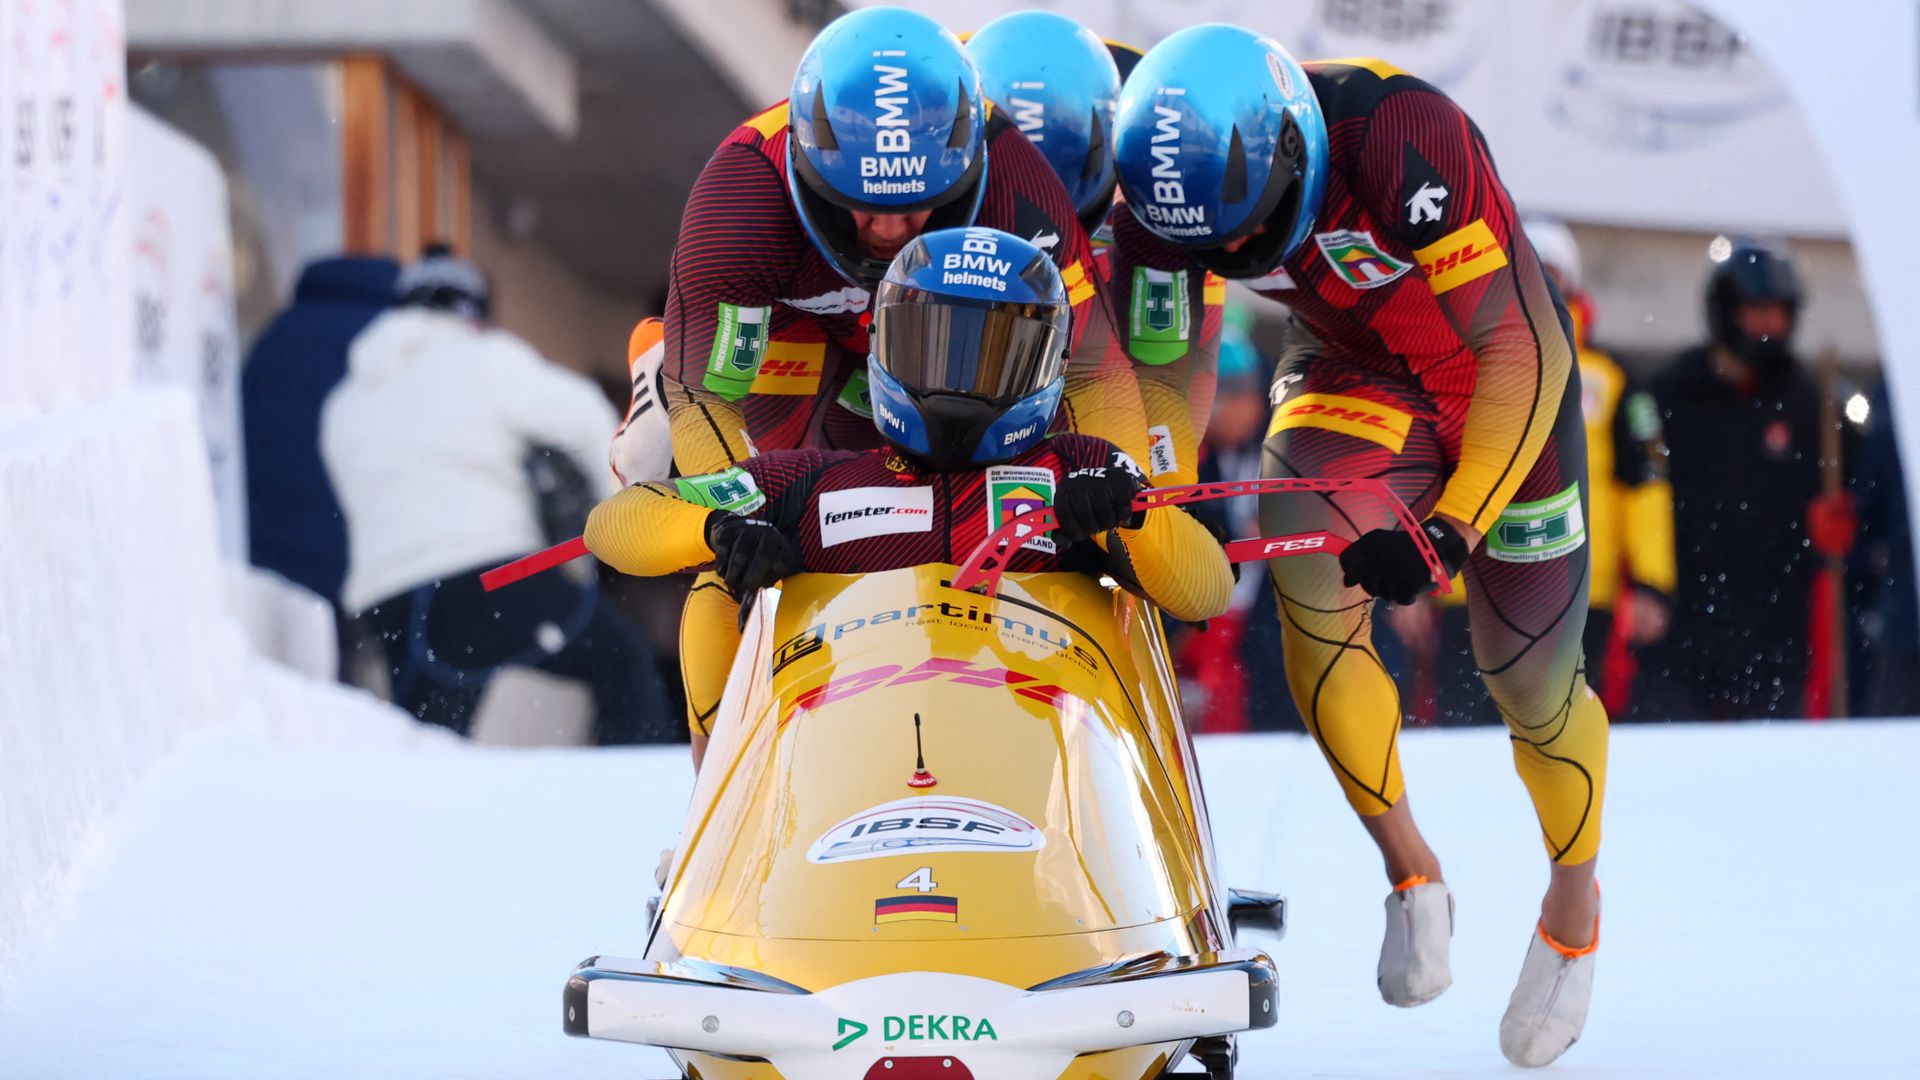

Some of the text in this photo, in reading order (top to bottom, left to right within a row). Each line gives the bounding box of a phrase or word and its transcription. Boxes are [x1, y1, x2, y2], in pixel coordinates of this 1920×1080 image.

[873, 65, 910, 153] BMW
[1151, 105, 1185, 204] BMW
[860, 156, 926, 177] BMW
[863, 179, 926, 194] helmets
[1146, 204, 1205, 225] BMW
[1153, 222, 1213, 237] helmets
[943, 254, 1012, 276] BMW
[943, 271, 1007, 292] helmets
[879, 403, 900, 430] BMW
[1288, 403, 1392, 430] DHL
[1004, 426, 1033, 445] BMW
[824, 506, 928, 526] fenster.com
[1264, 536, 1326, 553] FES
[834, 602, 1098, 671] partimus
[851, 817, 1005, 838] IBSF
[896, 867, 938, 892] 4
[883, 1015, 998, 1041] DEKRA
